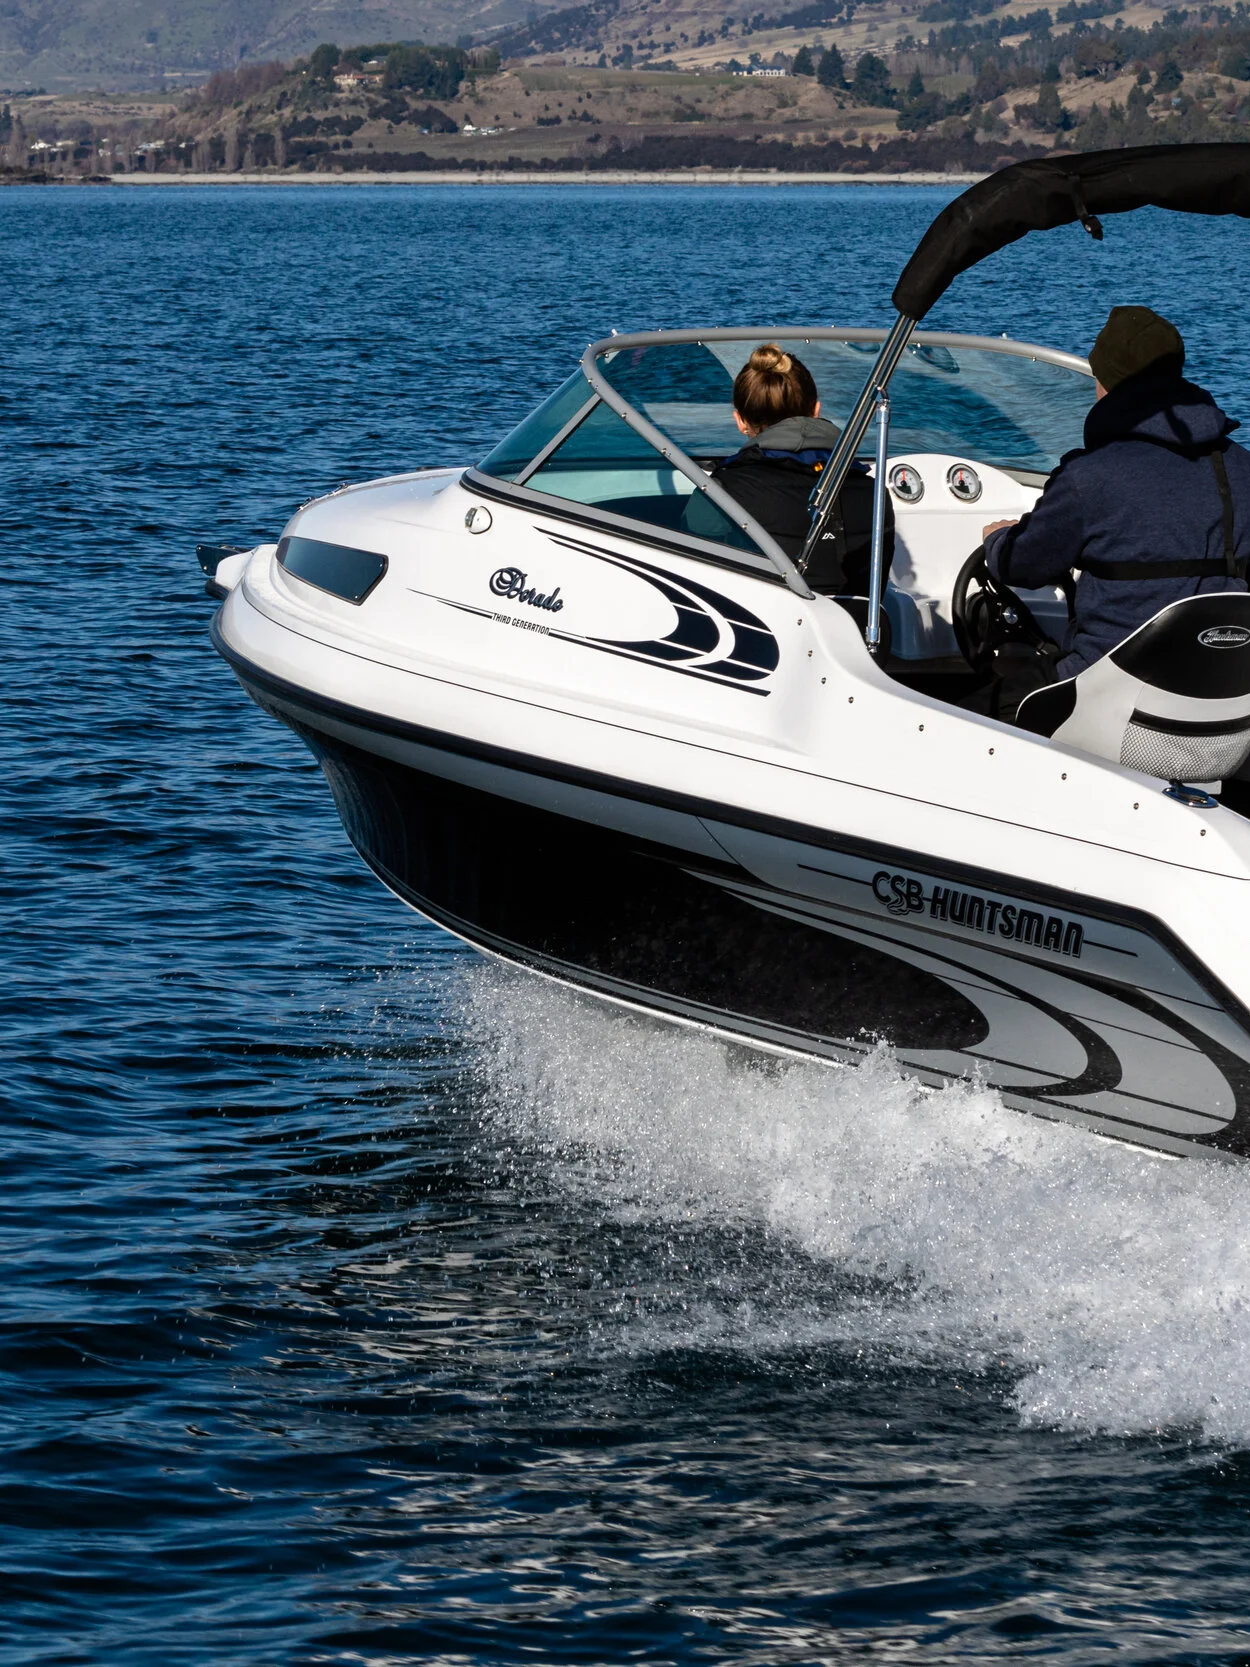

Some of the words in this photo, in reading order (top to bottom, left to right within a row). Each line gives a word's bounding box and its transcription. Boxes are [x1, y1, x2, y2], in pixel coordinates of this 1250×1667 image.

[489, 567, 563, 612] Dorado
[492, 612, 511, 625] THIRD
[511, 618, 550, 635] GENERATION
[872, 871, 926, 915] CSB
[930, 885, 1084, 958] HUNTSMAN
